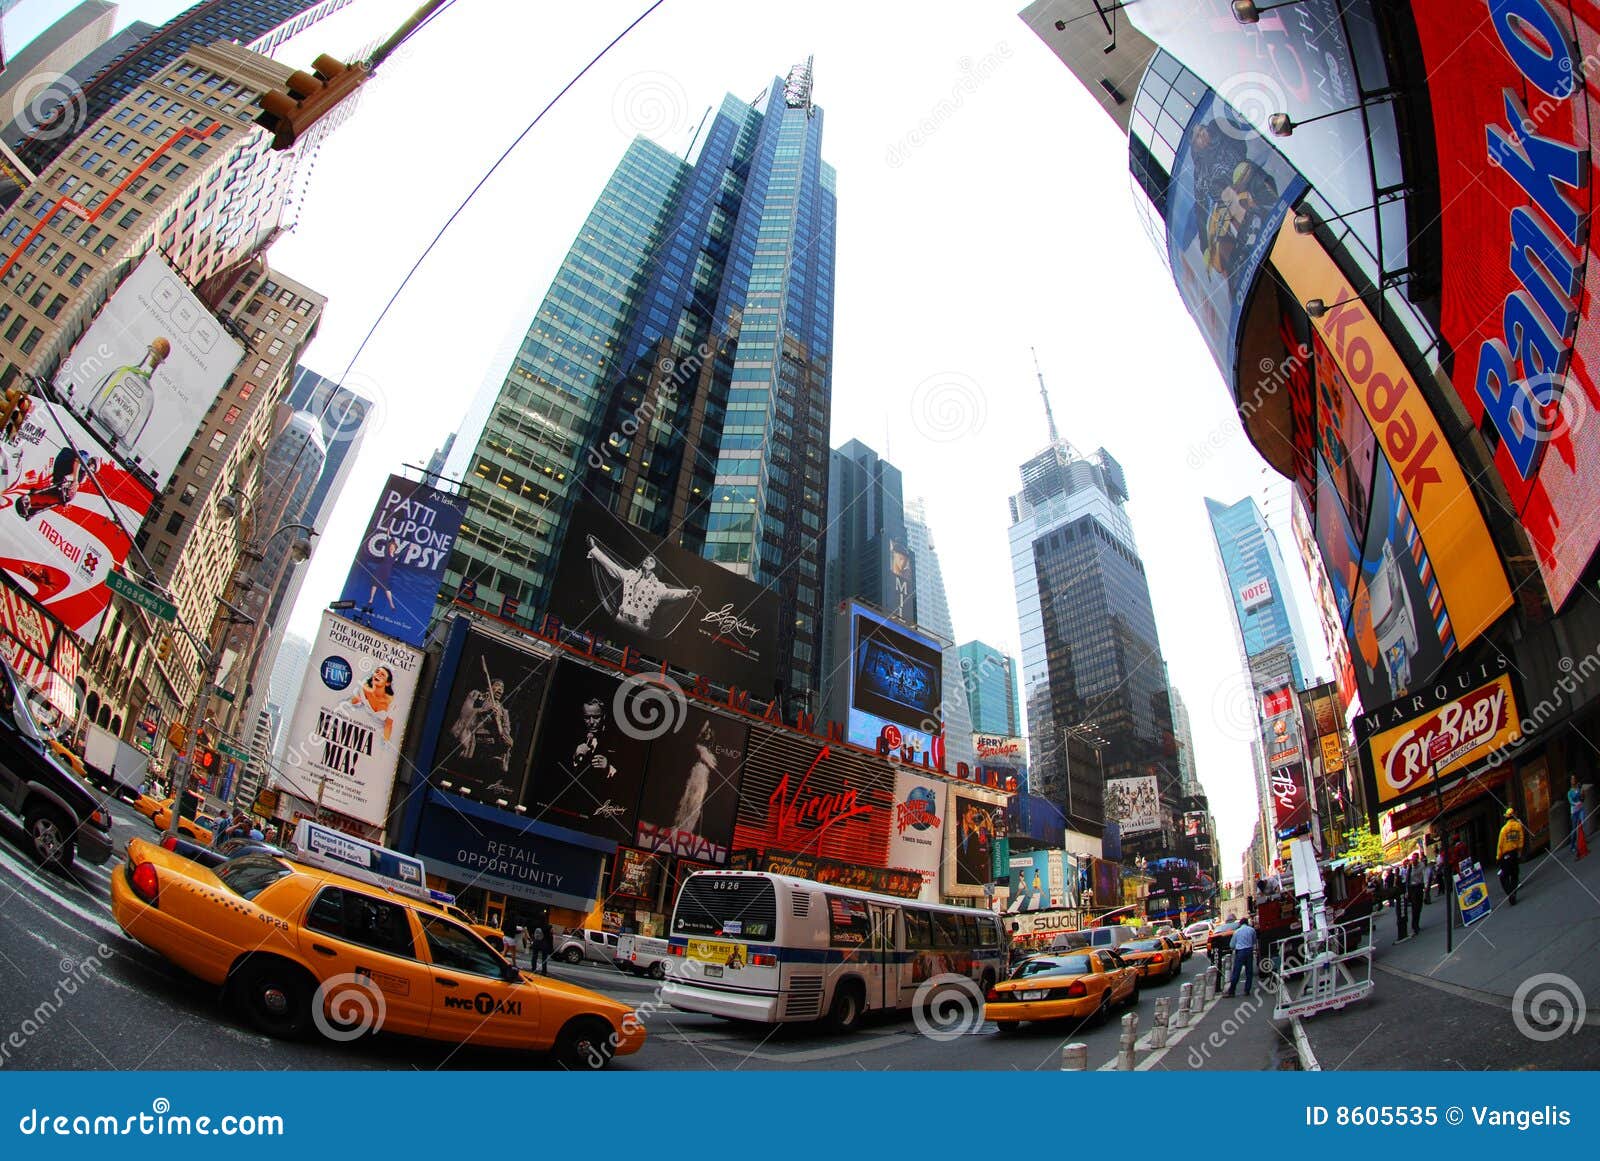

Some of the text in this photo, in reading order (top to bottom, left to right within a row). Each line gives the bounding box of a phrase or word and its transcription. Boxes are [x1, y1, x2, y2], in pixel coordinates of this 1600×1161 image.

[1324, 287, 1443, 512] Kodak
[385, 490, 437, 526] PATTI
[38, 519, 81, 563] maxell
[376, 510, 452, 551] LUPONE
[115, 579, 167, 616] Broadway
[1241, 582, 1268, 602] VOTE!
[329, 632, 369, 654] POPULAR
[390, 645, 417, 662] MOST
[1367, 654, 1507, 732] MARQUIS
[316, 711, 375, 757] MAMMA
[977, 736, 1004, 747] JERRY
[321, 741, 359, 777] MIA!
[768, 746, 873, 848] Virgin
[457, 849, 564, 887] OPPORTUNITY
[488, 840, 541, 866] RETAIL
[713, 880, 740, 891] 8626
[444, 996, 473, 1009] NYC
